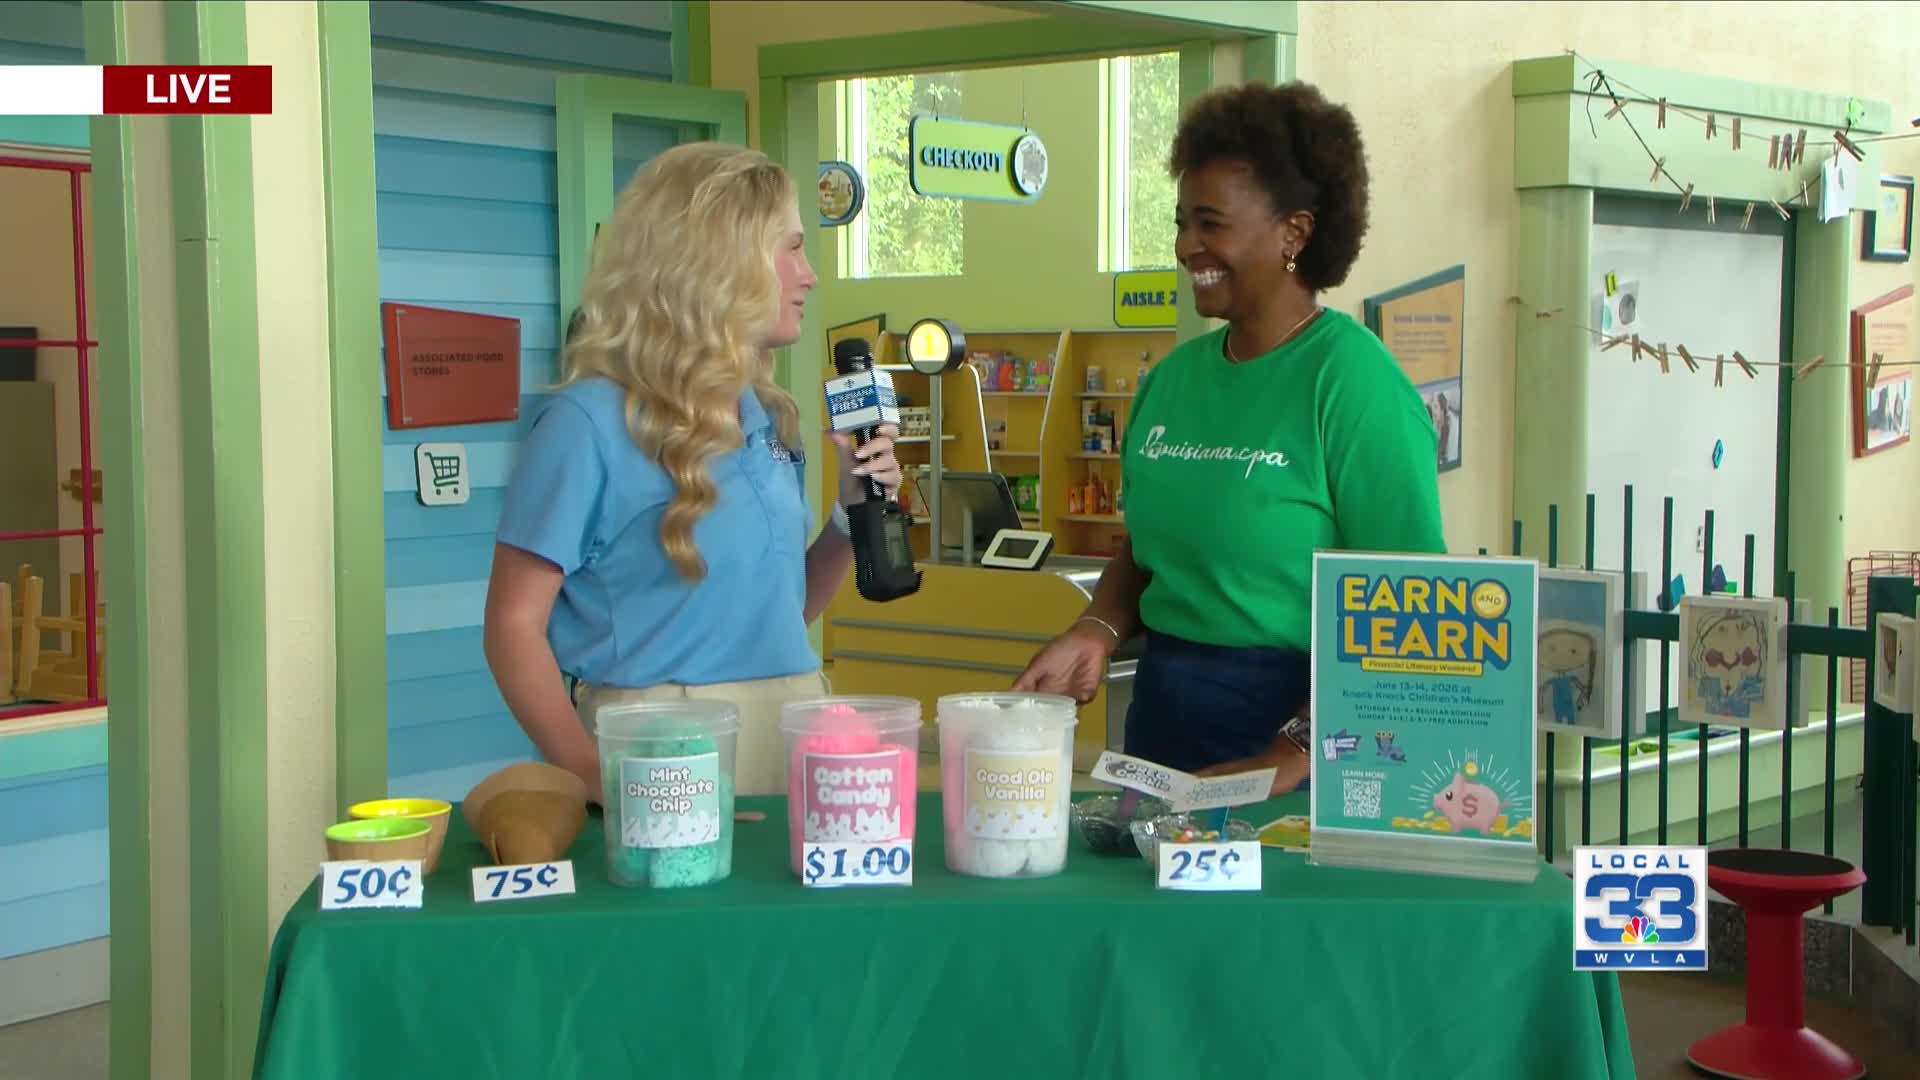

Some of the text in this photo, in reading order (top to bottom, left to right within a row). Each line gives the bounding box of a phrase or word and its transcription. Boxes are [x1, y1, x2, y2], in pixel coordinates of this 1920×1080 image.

[921, 145, 1005, 174] CHECKOUT
[1121, 291, 1165, 307] AISLE
[413, 352, 474, 362] ASSOCIATED
[412, 367, 450, 376] STORES
[831, 386, 875, 404] LOUISIANA
[832, 397, 865, 415] FIRST
[1343, 576, 1502, 616] EARN AND
[1343, 616, 1508, 662] LEARN
[1376, 681, 1397, 690] June
[1375, 690, 1405, 701] Knock
[1408, 692, 1459, 705] Children's
[1461, 695, 1504, 705] Museum
[650, 766, 691, 782] Mint
[813, 766, 893, 786] Cotton
[975, 767, 1054, 785] Good Ole
[1341, 769, 1364, 778] LEARN
[626, 778, 714, 797] Chocolate
[817, 782, 891, 809] Candy
[983, 783, 1046, 801] Vanilla
[649, 795, 693, 816] Chip
[805, 845, 911, 883] $1.00
[1168, 847, 1241, 882] 25¢
[334, 865, 412, 904] 50¢
[486, 864, 559, 898] 75¢
